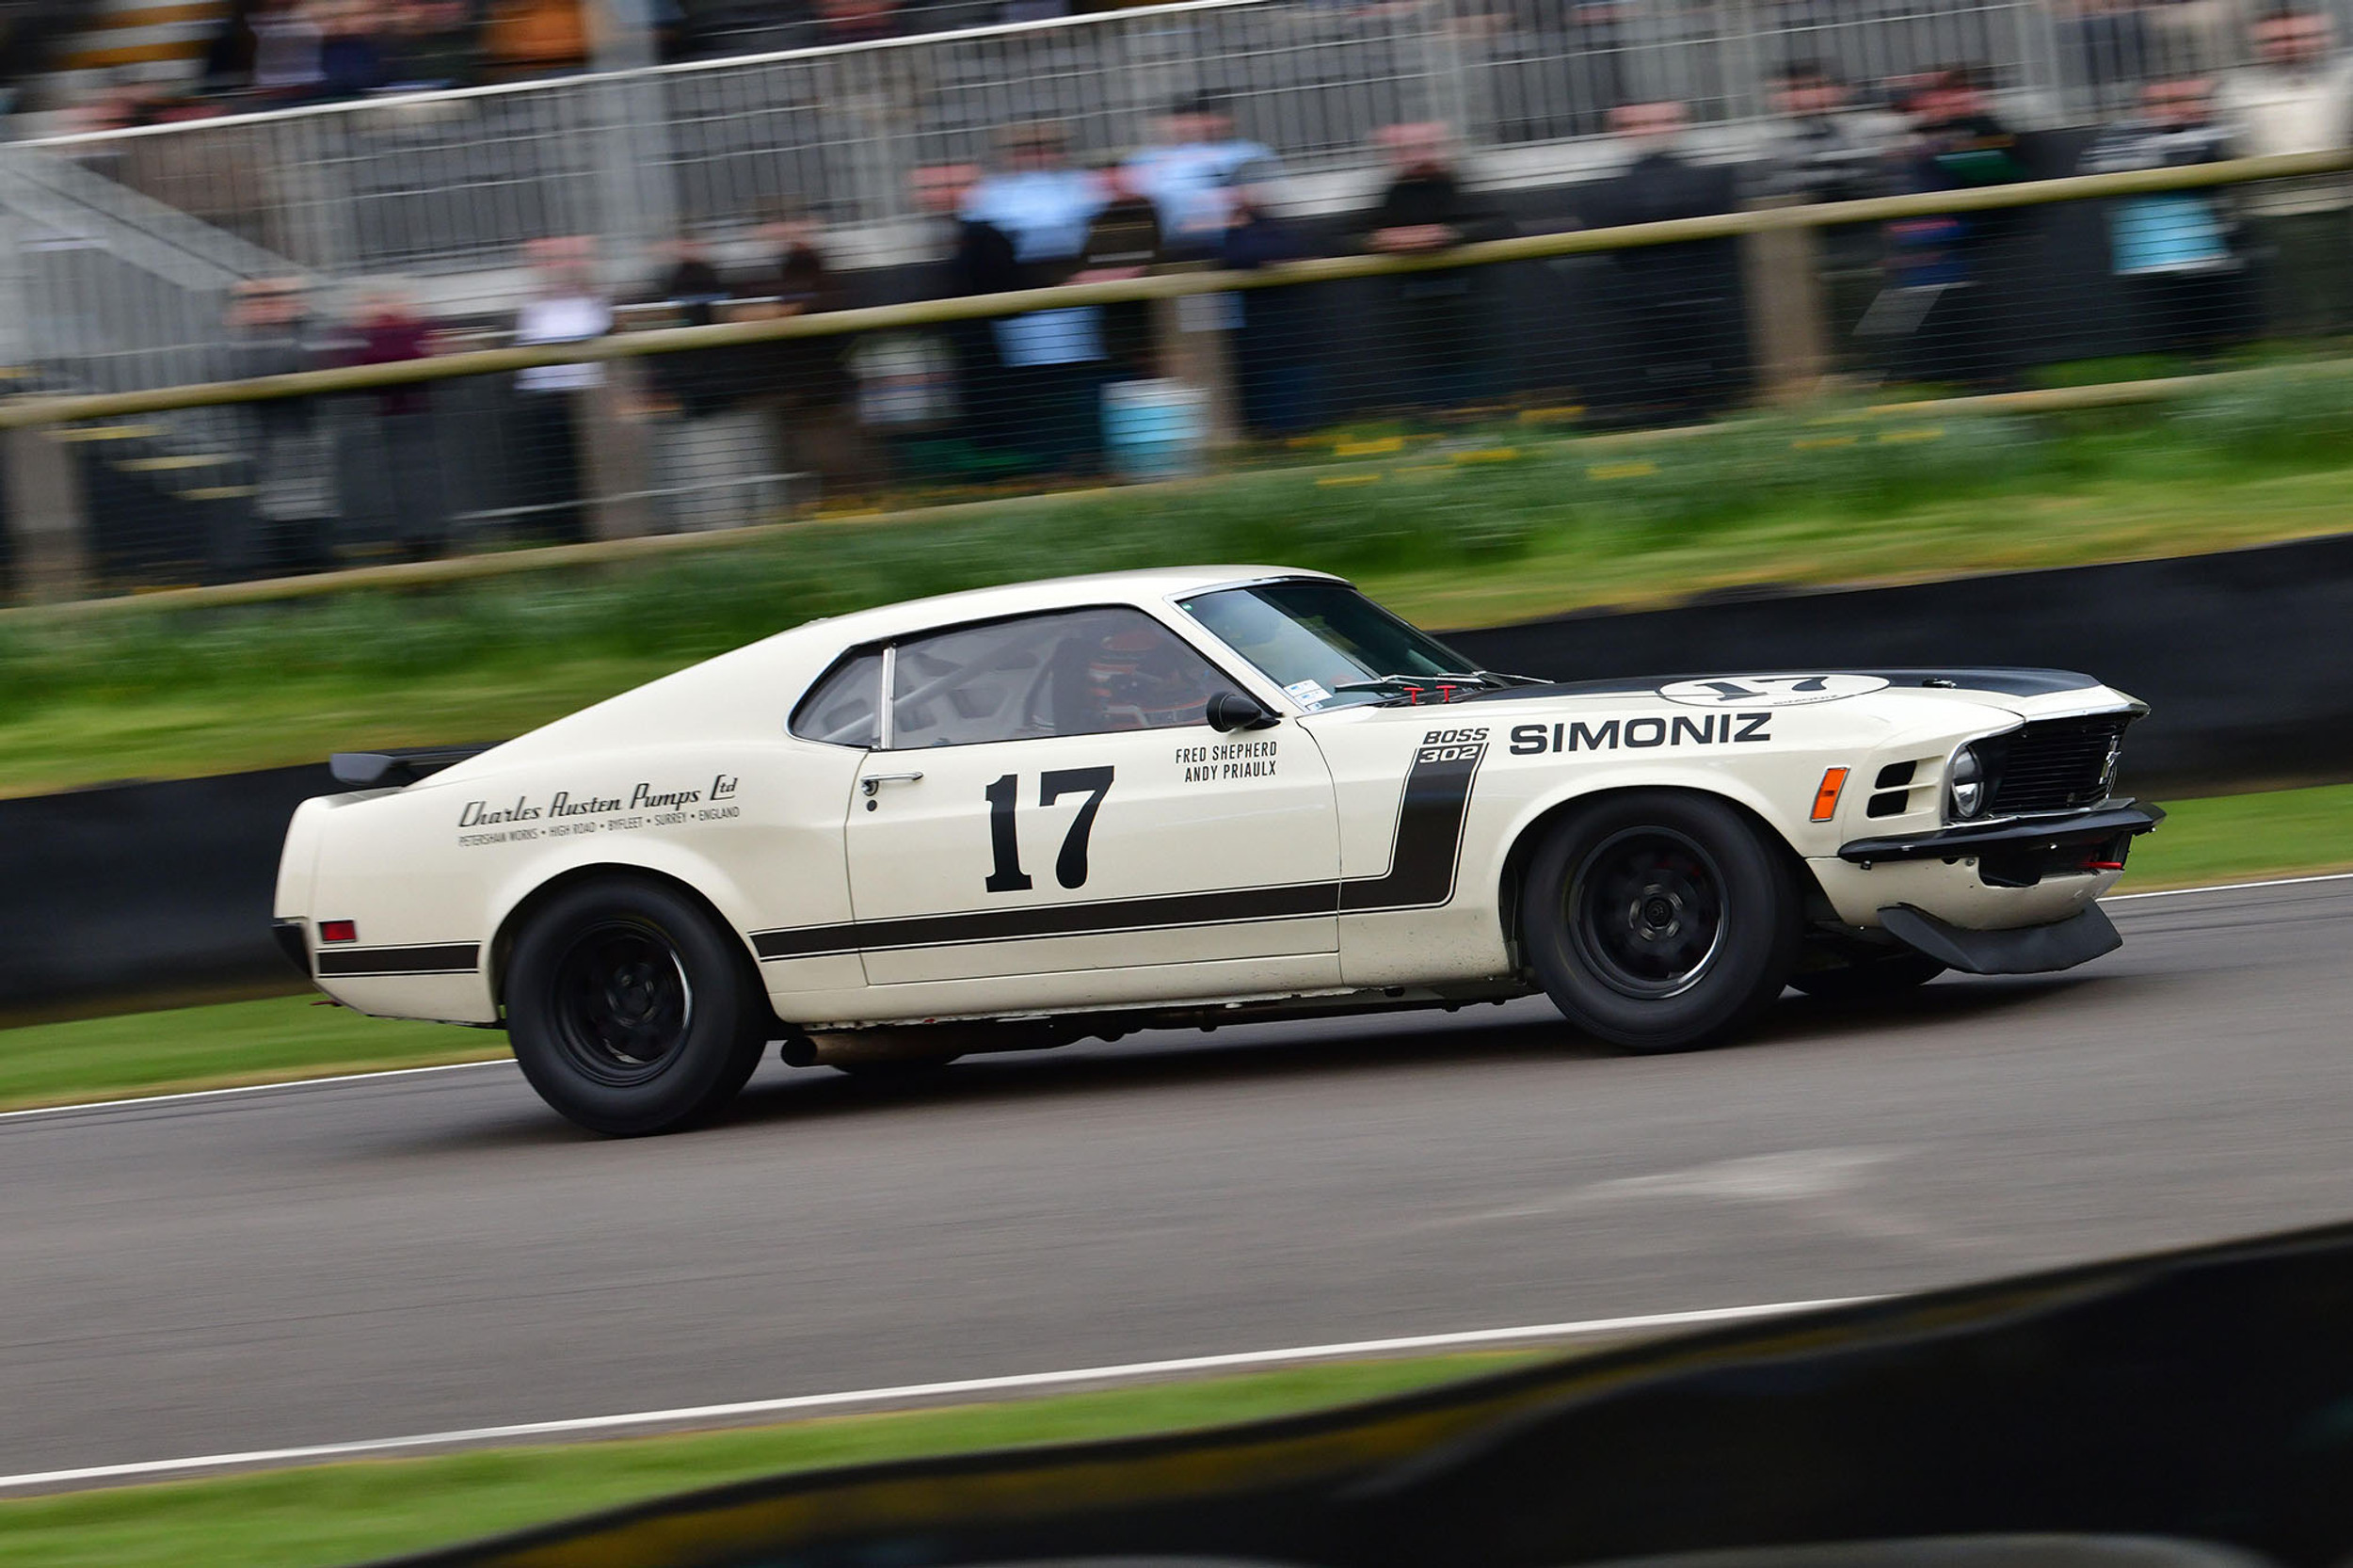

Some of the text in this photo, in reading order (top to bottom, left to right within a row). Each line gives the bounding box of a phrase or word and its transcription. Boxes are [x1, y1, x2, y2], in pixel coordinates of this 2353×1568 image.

[1694, 676, 1830, 702] 17
[1422, 728, 1490, 744] BOSS
[1509, 712, 1772, 756] SIMONIZ
[1176, 741, 1277, 764] FRED SHEPHERD
[1419, 745, 1479, 763] 302
[1185, 760, 1276, 783] ANDY PRIAULX
[458, 774, 739, 827] Charles Austen Pumps Ltd
[509, 828, 539, 841] WORKS
[549, 824, 570, 837] HIGH
[573, 822, 596, 834] ROAD
[607, 817, 643, 831] BYFLEET
[654, 811, 687, 825] SURREY
[699, 807, 740, 822] ENGLAND
[985, 765, 1114, 893] 17
